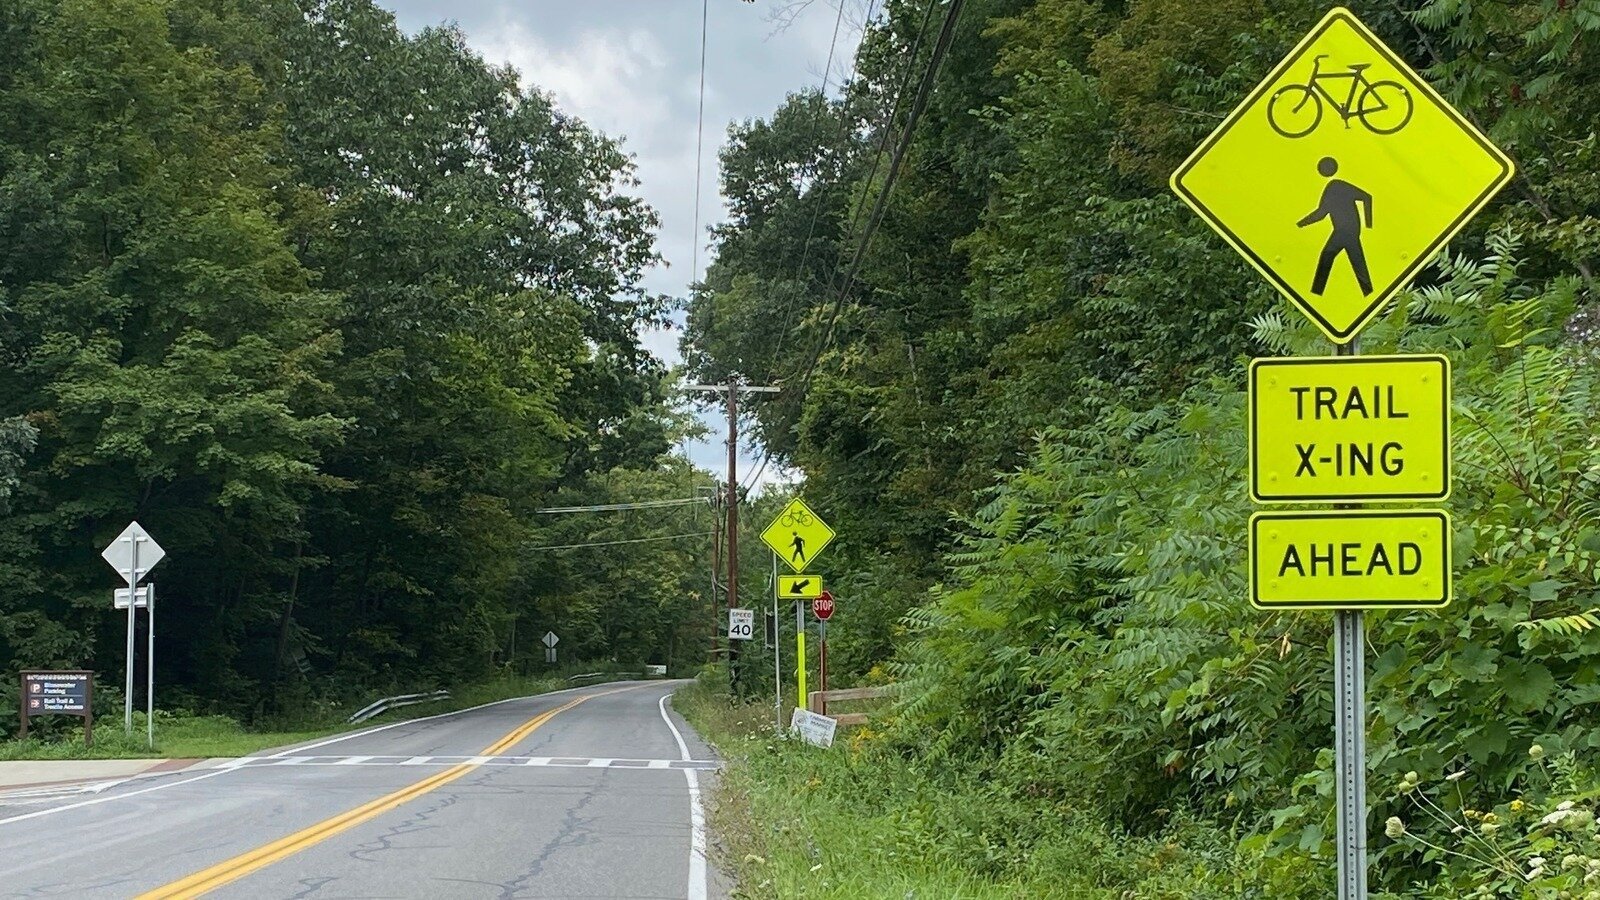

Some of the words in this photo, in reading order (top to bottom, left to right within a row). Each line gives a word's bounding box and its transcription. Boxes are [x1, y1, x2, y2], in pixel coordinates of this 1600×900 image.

[1290, 385, 1409, 420] TRAIL
[1294, 441, 1404, 477] X-ING
[1278, 542, 1422, 577] AHEAD
[814, 600, 833, 611] STOP
[731, 624, 751, 636] 40
